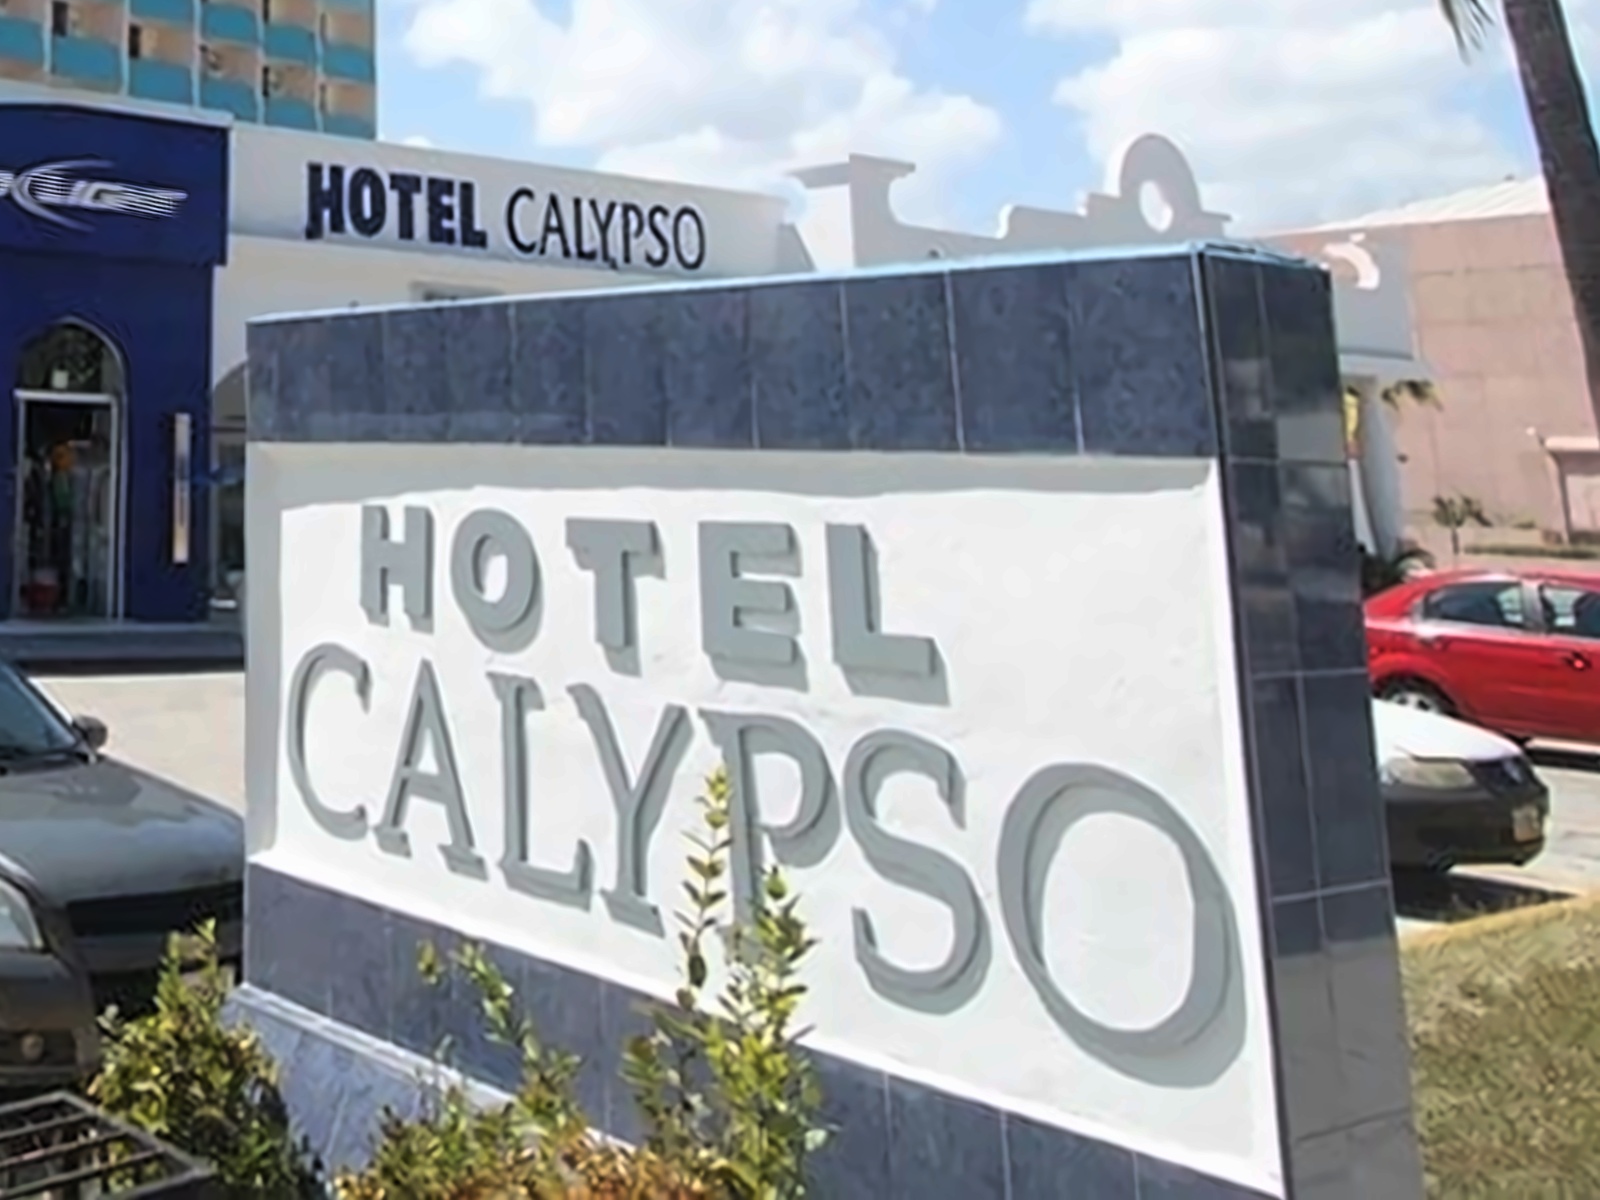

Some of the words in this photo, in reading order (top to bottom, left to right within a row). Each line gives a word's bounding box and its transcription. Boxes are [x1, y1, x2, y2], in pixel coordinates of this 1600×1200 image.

[305, 161, 488, 250] HOTEL
[505, 187, 706, 271] CALYPSO
[360, 504, 951, 707] HOTEL
[286, 641, 1248, 1089] CALYPSO
